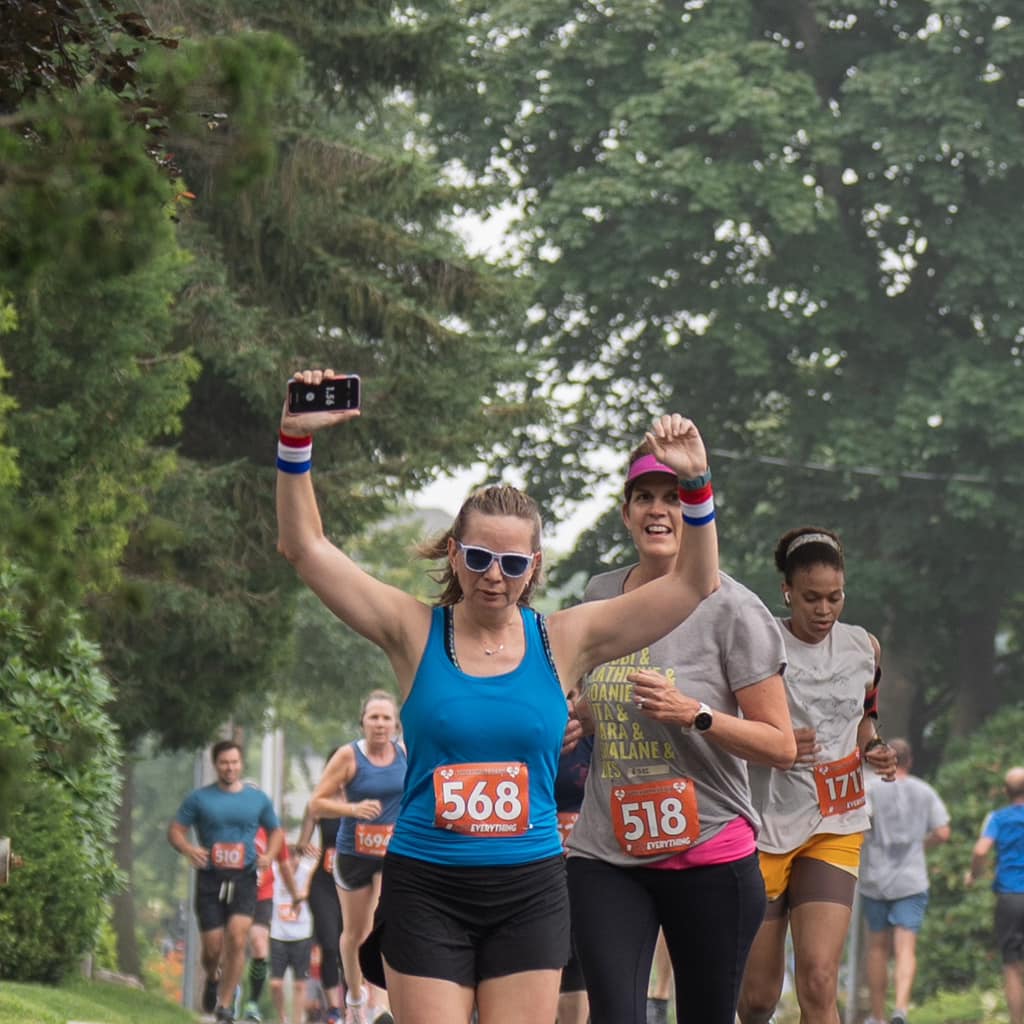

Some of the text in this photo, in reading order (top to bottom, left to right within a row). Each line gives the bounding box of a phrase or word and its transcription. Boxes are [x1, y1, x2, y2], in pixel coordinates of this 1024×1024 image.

[588, 683, 633, 703] OANIE
[441, 781, 522, 820] 568
[470, 823, 517, 833] EVERYTHING
[621, 797, 687, 841] 518
[646, 836, 691, 850] EVERYTHING
